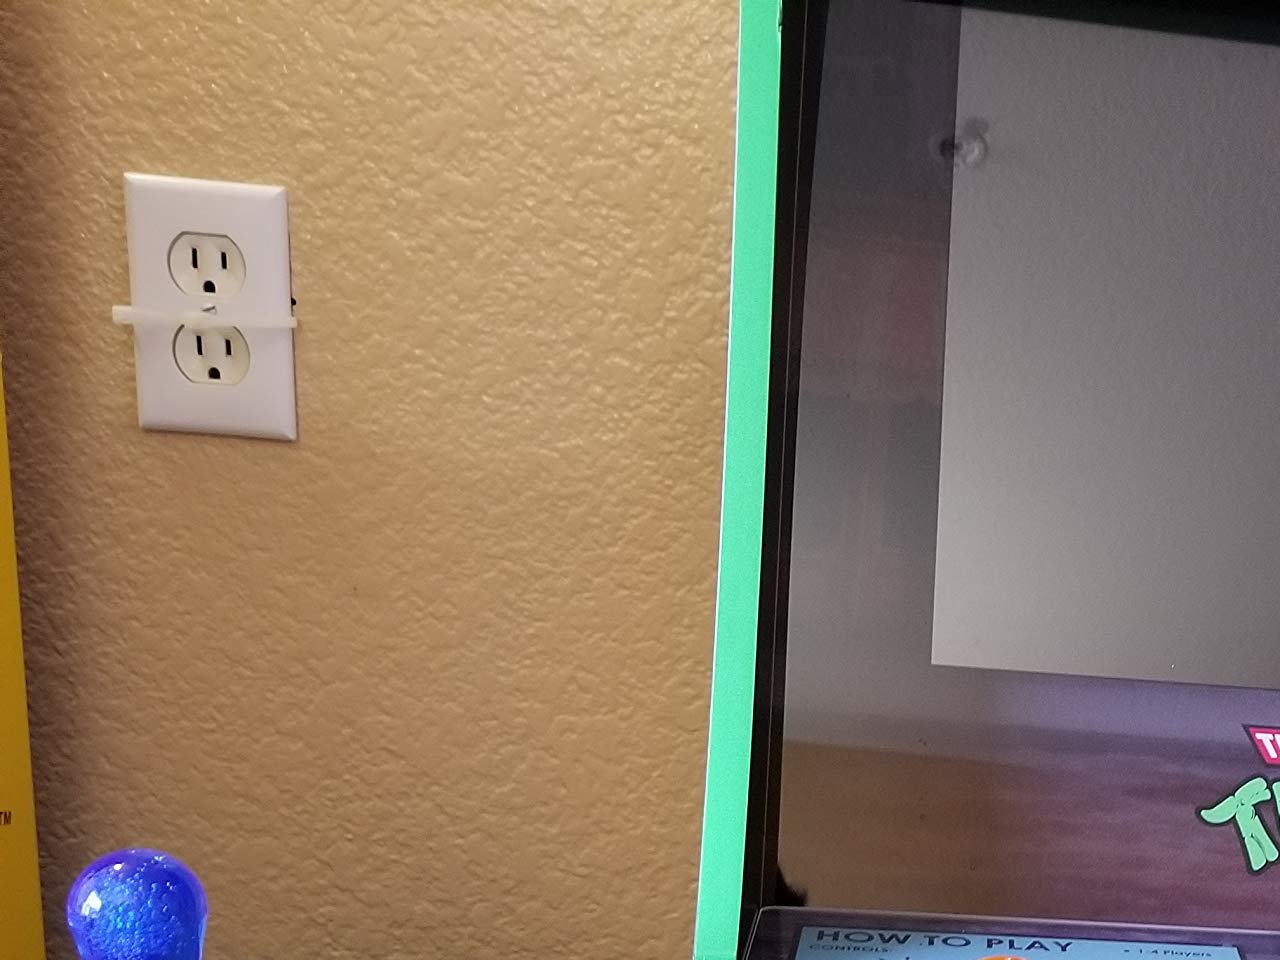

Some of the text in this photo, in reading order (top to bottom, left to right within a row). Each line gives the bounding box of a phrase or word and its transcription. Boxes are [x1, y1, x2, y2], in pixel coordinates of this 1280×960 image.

[816, 930, 1073, 953] HOW TO PLAY
[1163, 949, 1213, 958] Players
